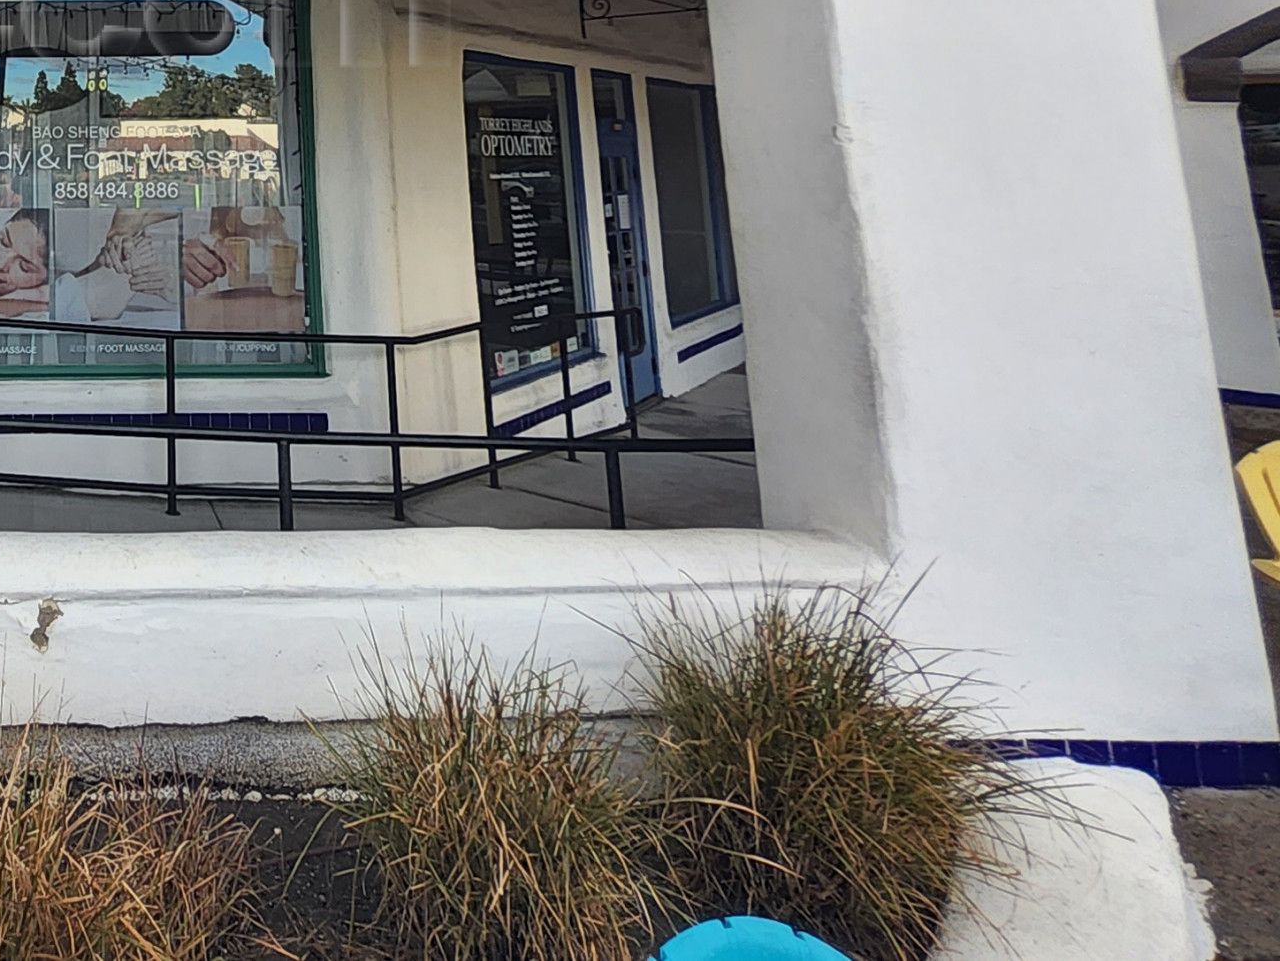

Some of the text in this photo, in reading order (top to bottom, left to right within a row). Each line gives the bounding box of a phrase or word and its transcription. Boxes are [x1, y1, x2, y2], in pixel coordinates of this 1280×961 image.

[32, 125, 64, 139] BAO
[67, 125, 121, 139] SHENG
[480, 134, 554, 157] OPTOMETRY
[37, 143, 61, 170] &
[142, 143, 279, 174] Massage
